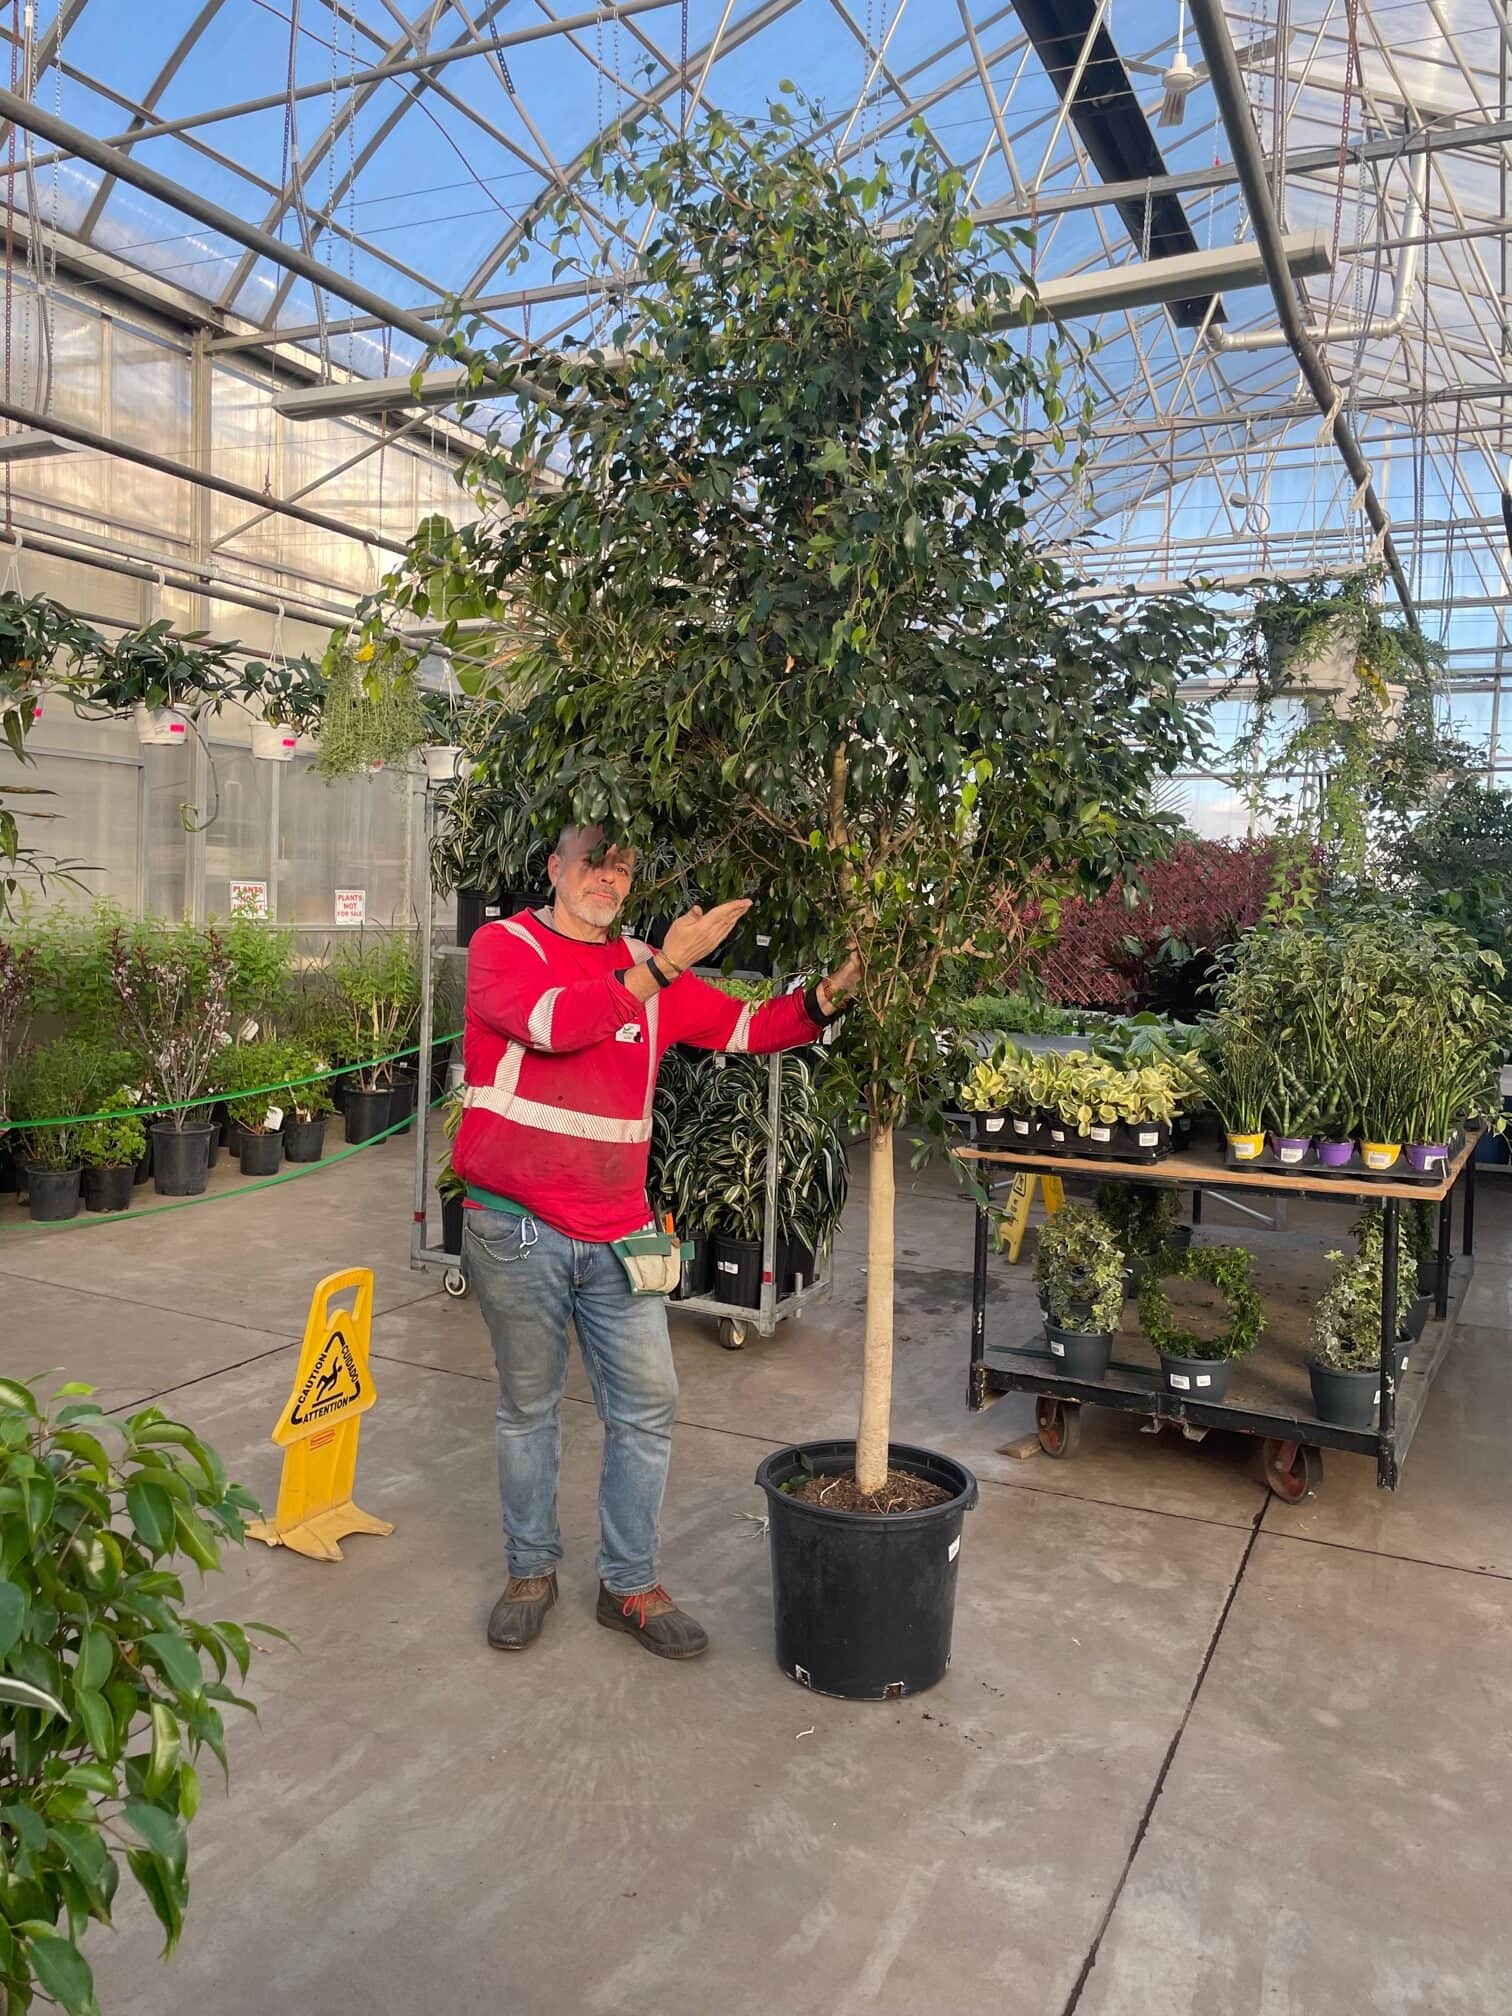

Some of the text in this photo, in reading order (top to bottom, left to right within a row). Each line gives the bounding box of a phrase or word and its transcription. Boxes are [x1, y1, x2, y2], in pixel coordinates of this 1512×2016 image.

[298, 1353, 327, 1404] CAUTION
[341, 1345, 359, 1383] CUIDADO
[302, 1397, 350, 1424] ATTENTION
